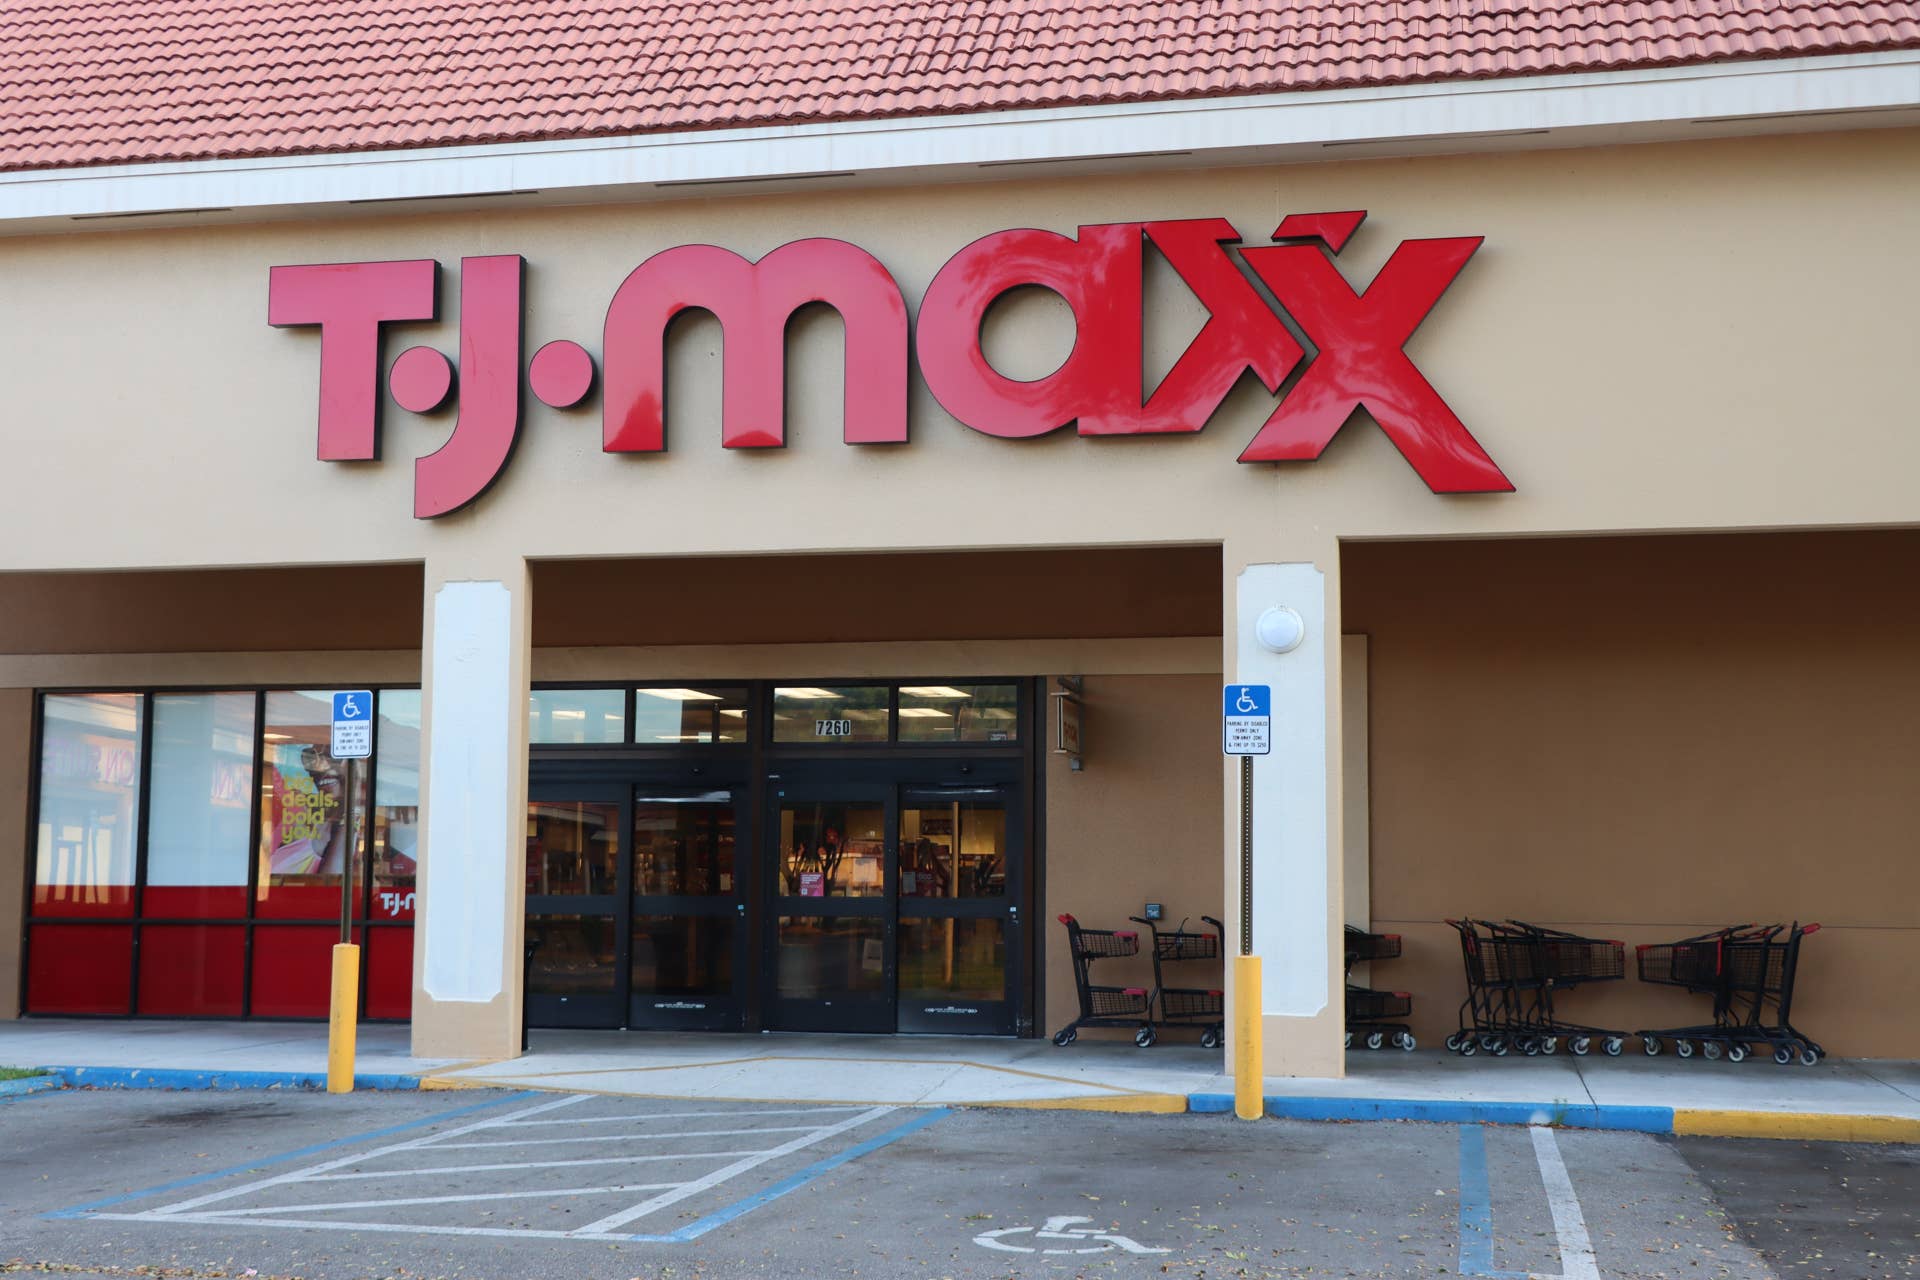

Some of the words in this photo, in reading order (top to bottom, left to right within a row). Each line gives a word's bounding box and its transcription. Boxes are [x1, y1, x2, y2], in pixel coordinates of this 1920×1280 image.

[817, 720, 850, 735] 7260
[283, 772, 314, 795] big
[282, 789, 339, 808] deals.
[282, 807, 325, 825] bold
[282, 825, 321, 844] you.
